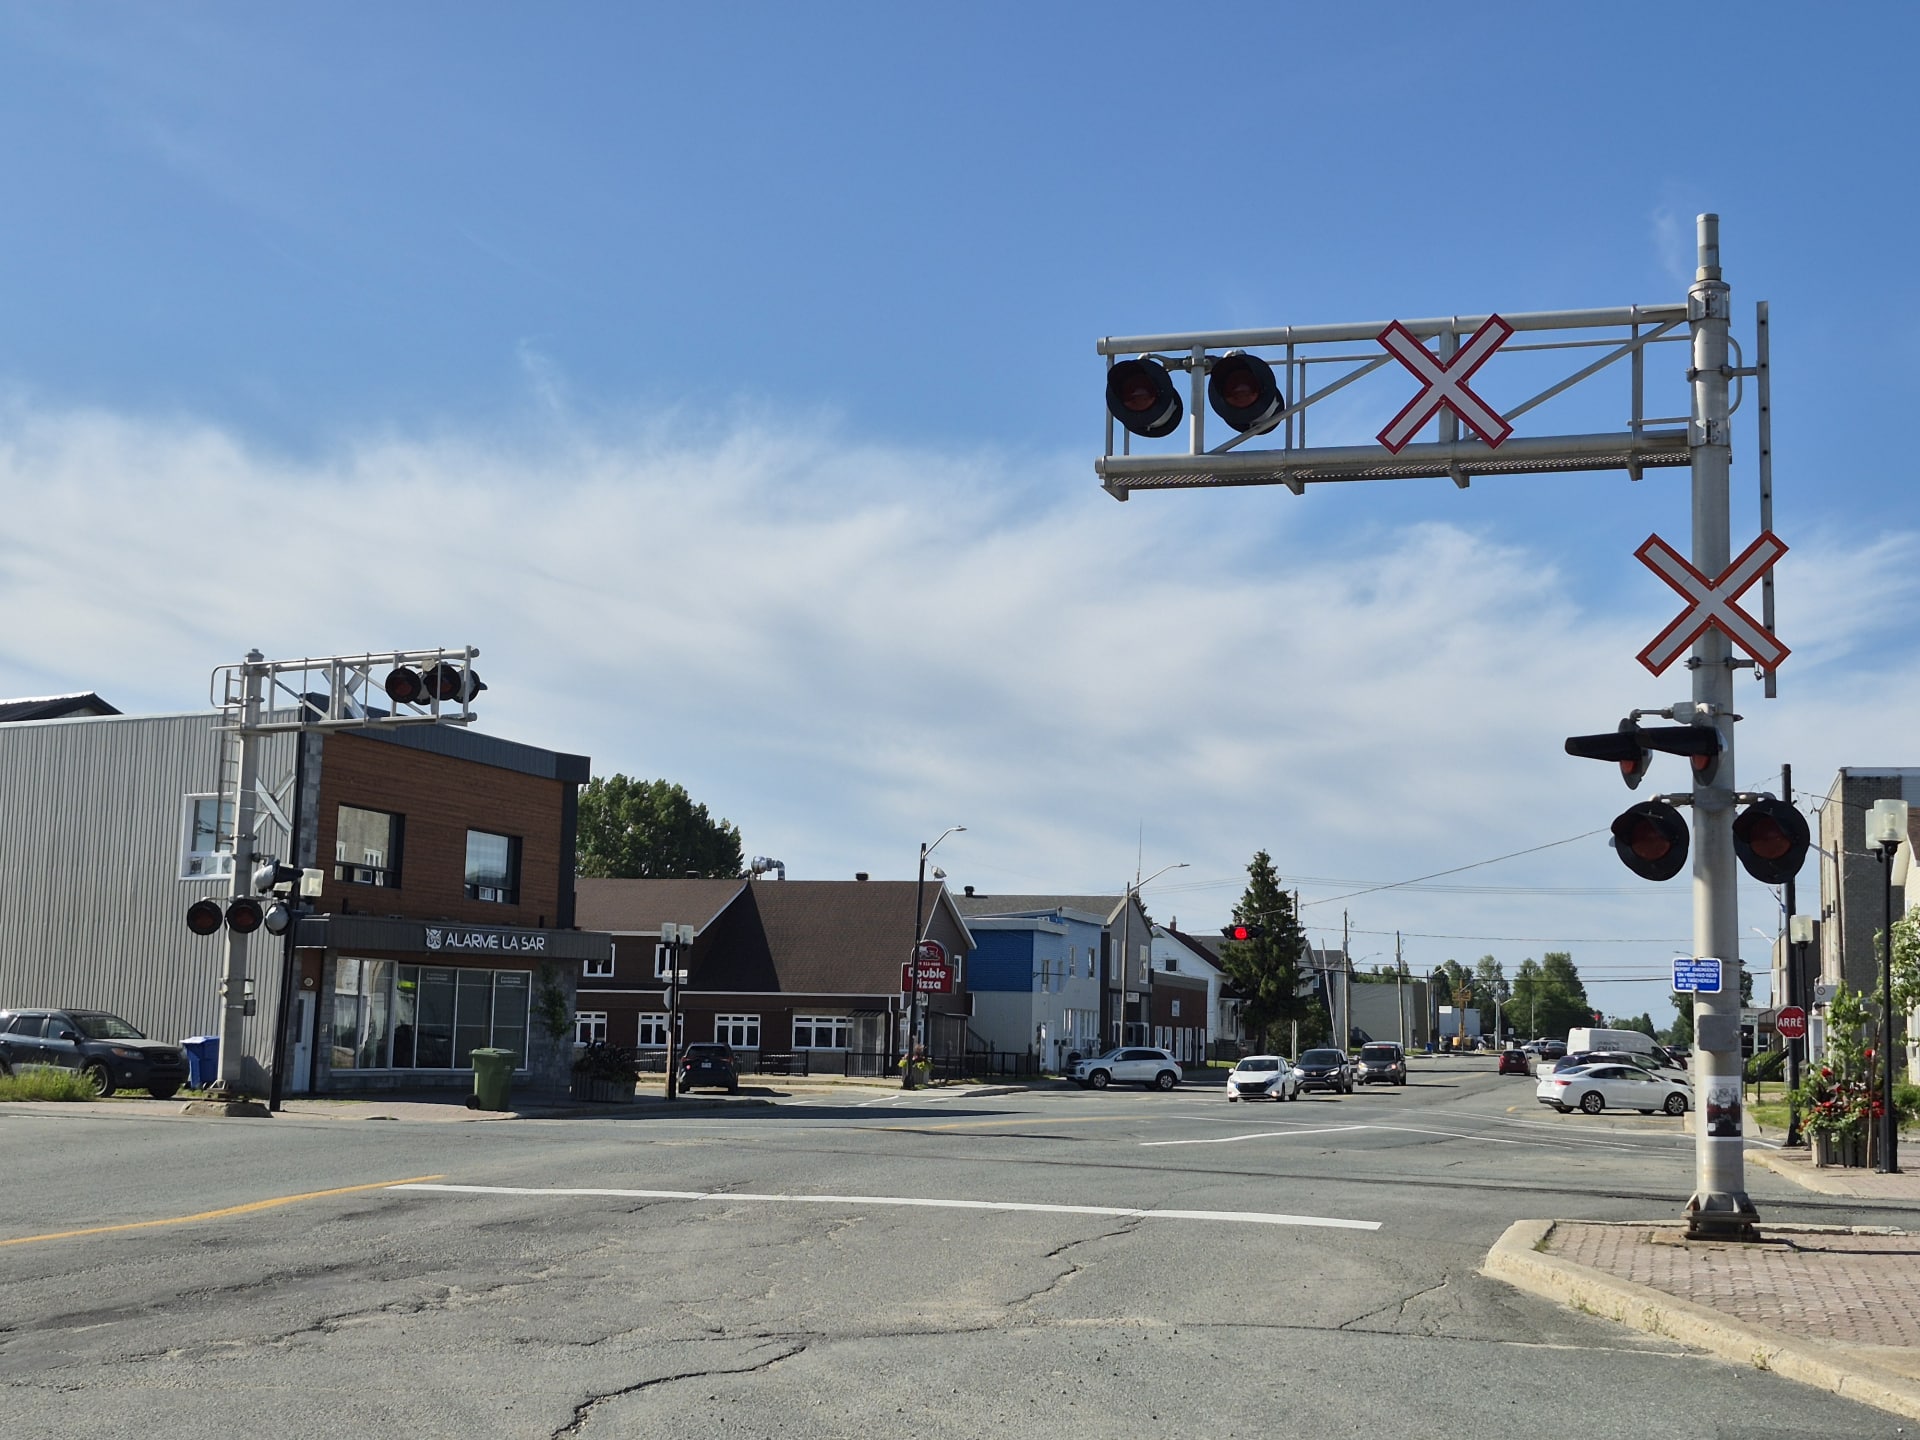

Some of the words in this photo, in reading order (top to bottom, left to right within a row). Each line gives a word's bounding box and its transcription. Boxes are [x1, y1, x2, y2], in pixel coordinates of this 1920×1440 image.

[445, 932, 499, 949] ALARME
[502, 935, 519, 950] LA
[521, 936, 545, 951] SAR
[917, 979, 942, 989] izza
